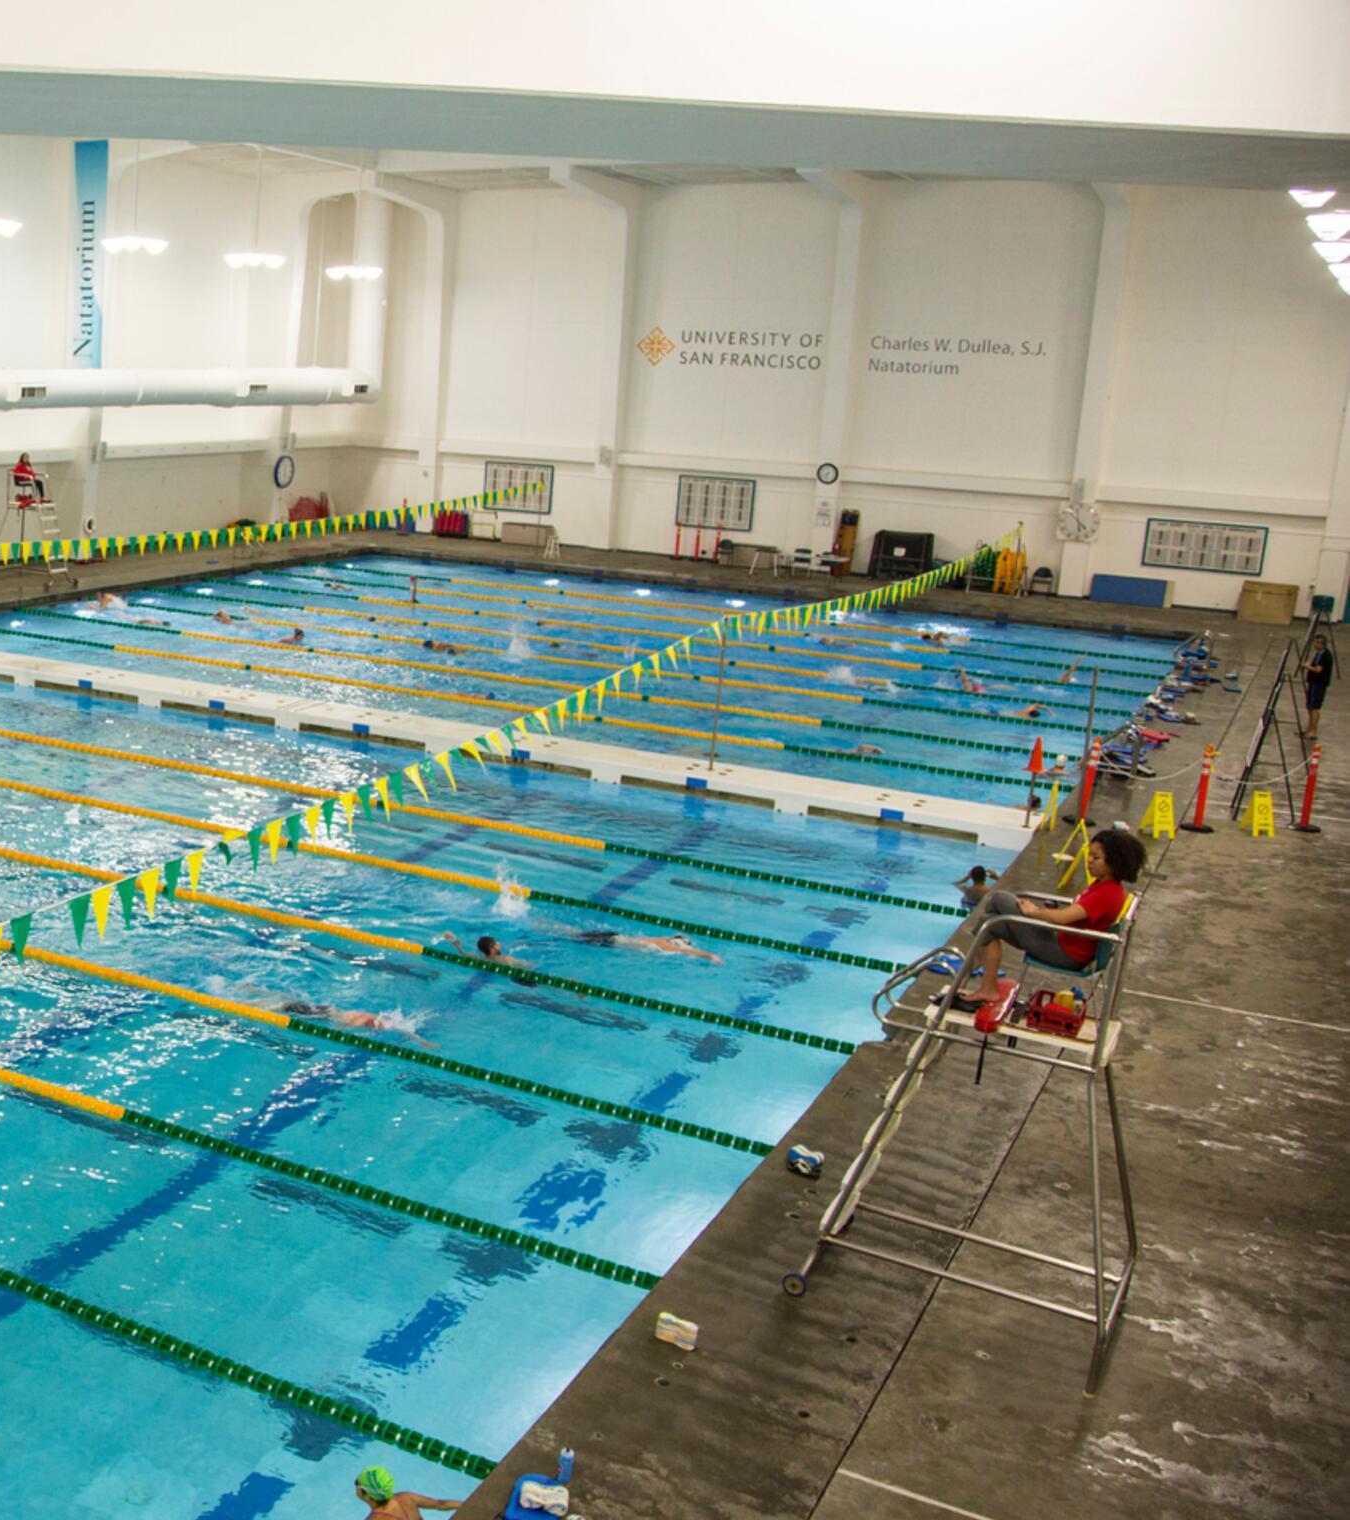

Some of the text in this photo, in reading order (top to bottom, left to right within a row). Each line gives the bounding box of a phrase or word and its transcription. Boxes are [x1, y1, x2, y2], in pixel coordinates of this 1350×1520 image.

[73, 200, 96, 358] Natatorium
[681, 330, 824, 348] UNIVERSITY OF
[870, 335, 1047, 357] Charles W. Dullea, S.J.
[679, 351, 823, 371] SAN FRANCISCO
[867, 358, 960, 376] Natatorium
